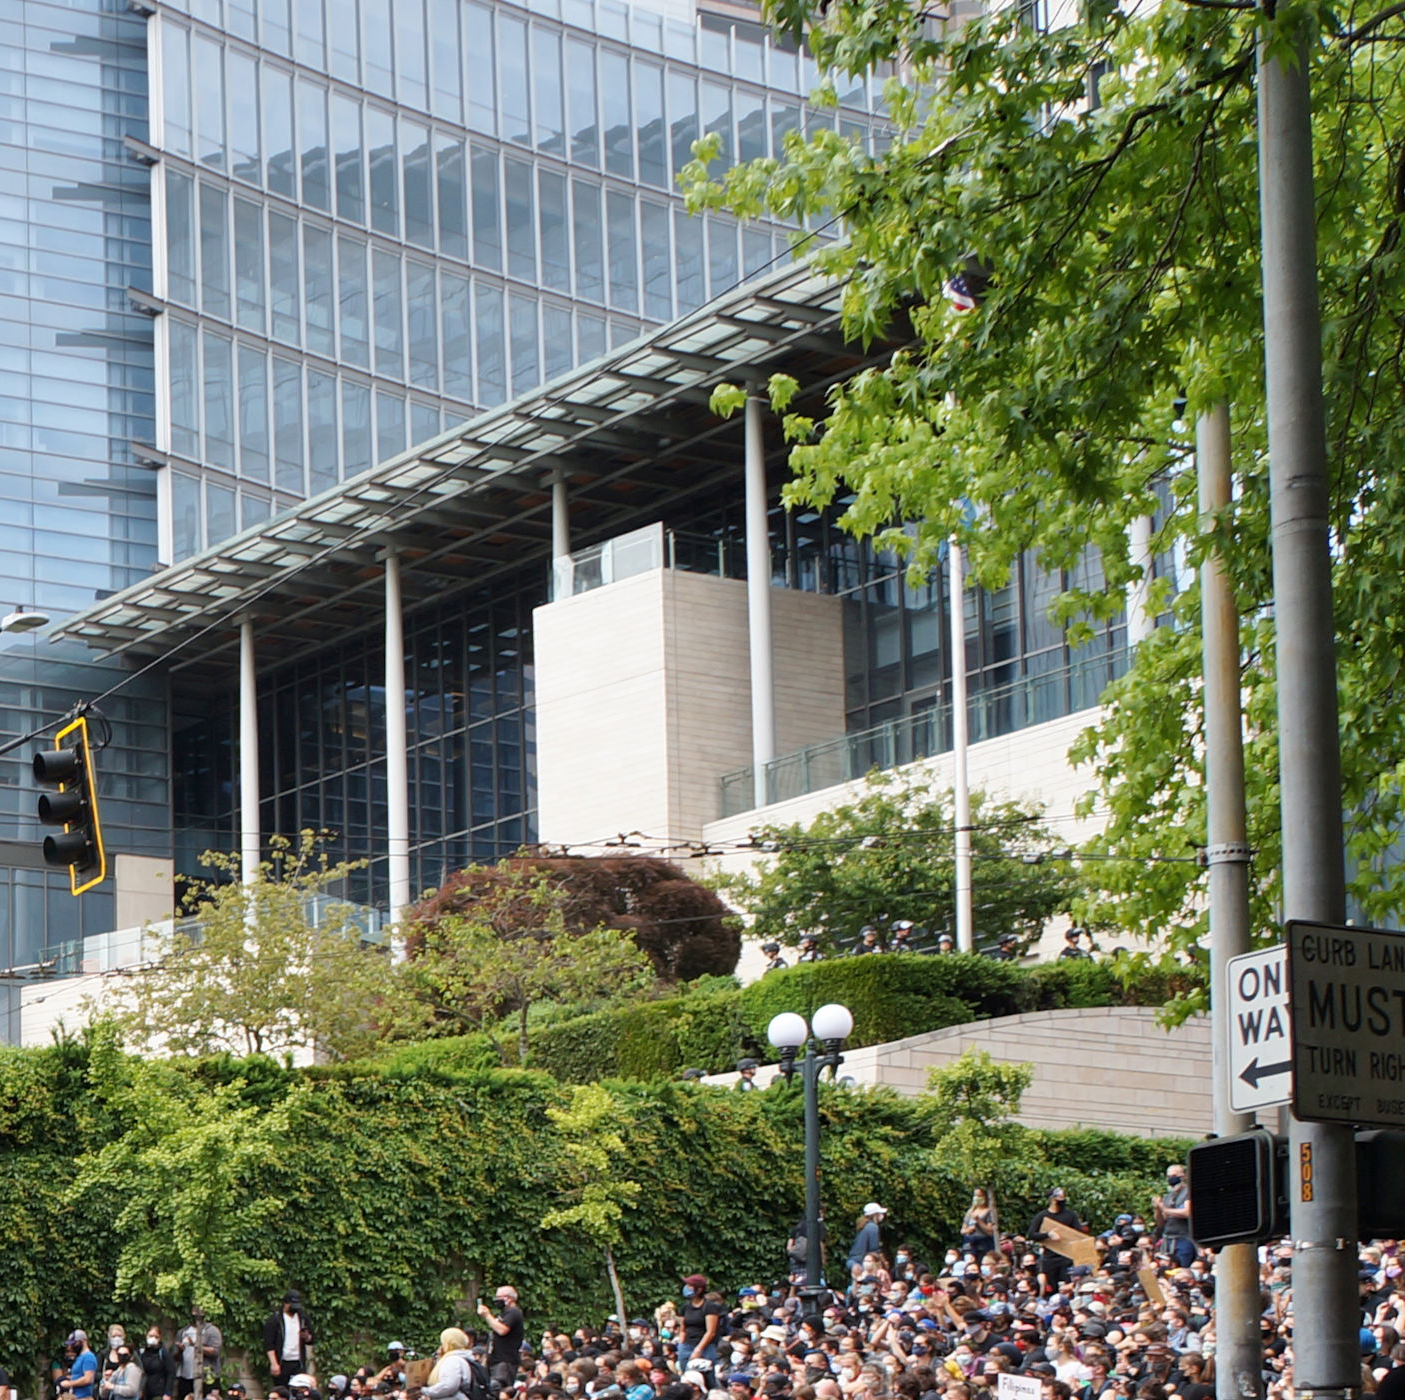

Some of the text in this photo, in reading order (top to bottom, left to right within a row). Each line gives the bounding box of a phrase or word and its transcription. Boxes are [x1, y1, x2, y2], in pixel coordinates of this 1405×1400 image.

[1302, 934, 1357, 967] CURB
[1305, 1046, 1357, 1077] TURN
[1318, 1093, 1361, 1112] EXCEPT
[1301, 1143, 1312, 1201] 508
